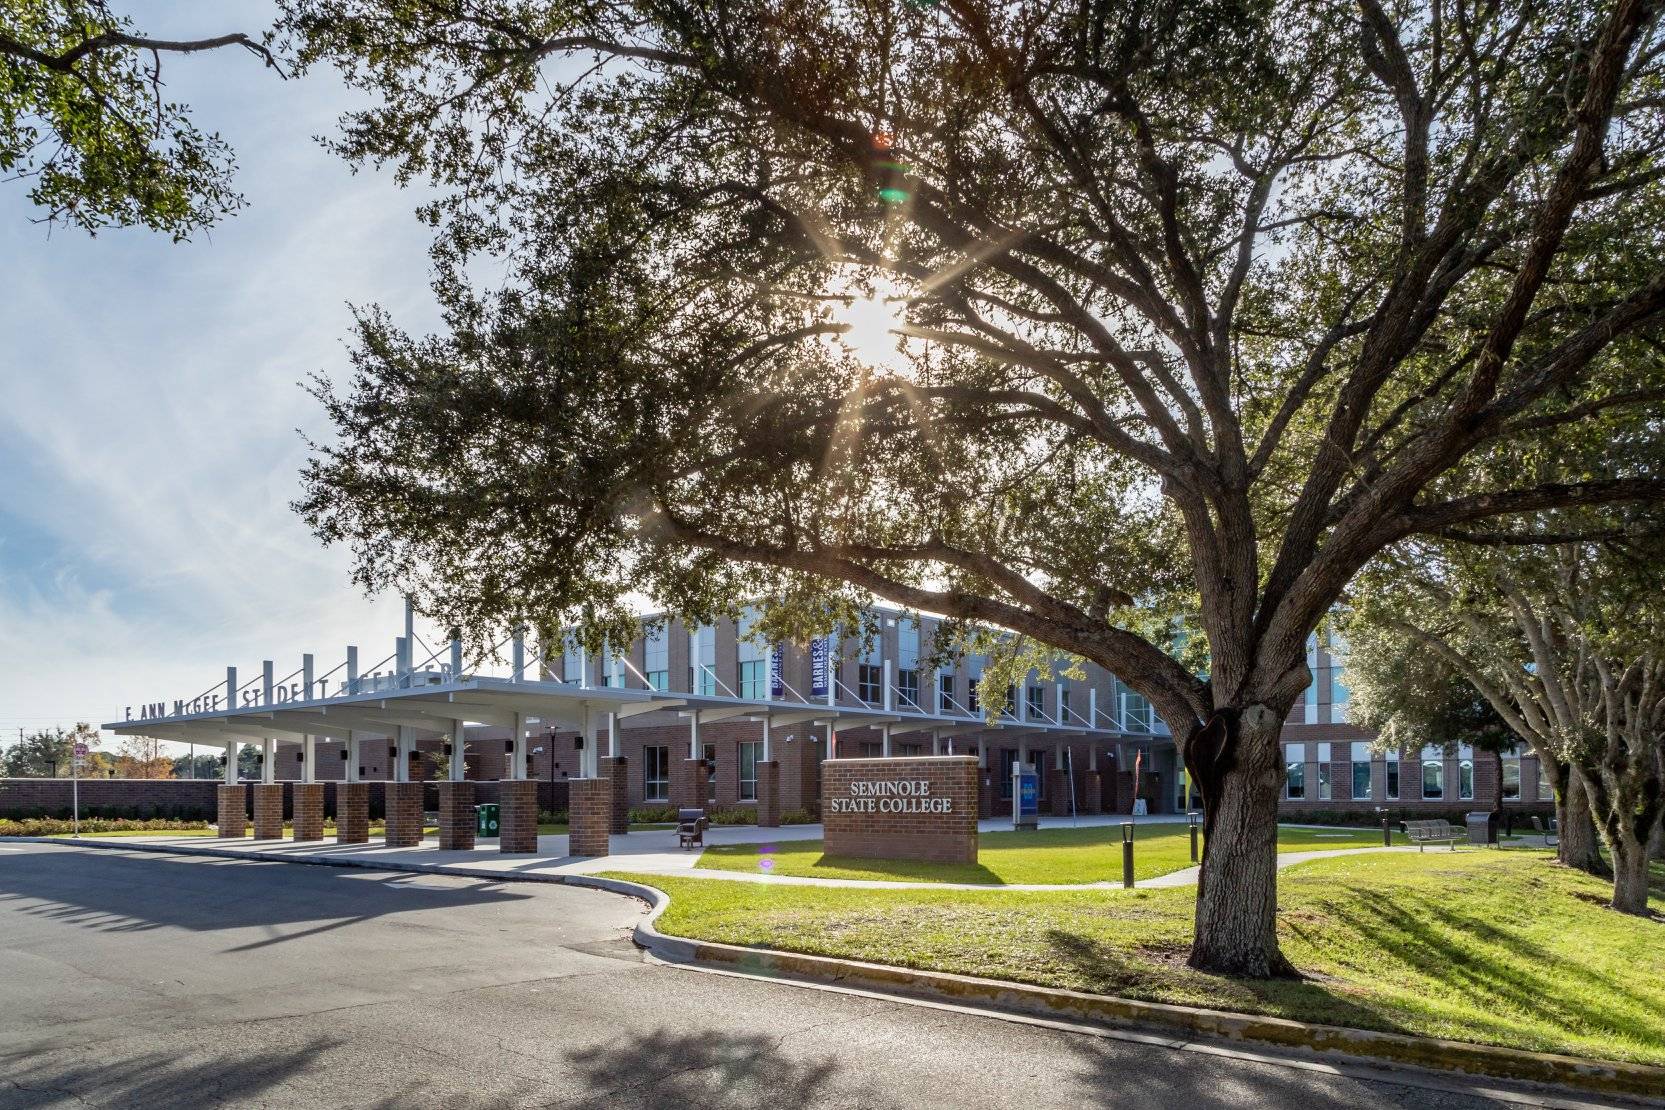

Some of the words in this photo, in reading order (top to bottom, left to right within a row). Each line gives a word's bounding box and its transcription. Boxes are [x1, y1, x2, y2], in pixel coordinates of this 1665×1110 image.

[141, 702, 165, 720] ANN
[850, 780, 930, 796] SEMINOLE
[831, 798, 877, 812] STATE
[879, 798, 952, 813] COLLEGE
